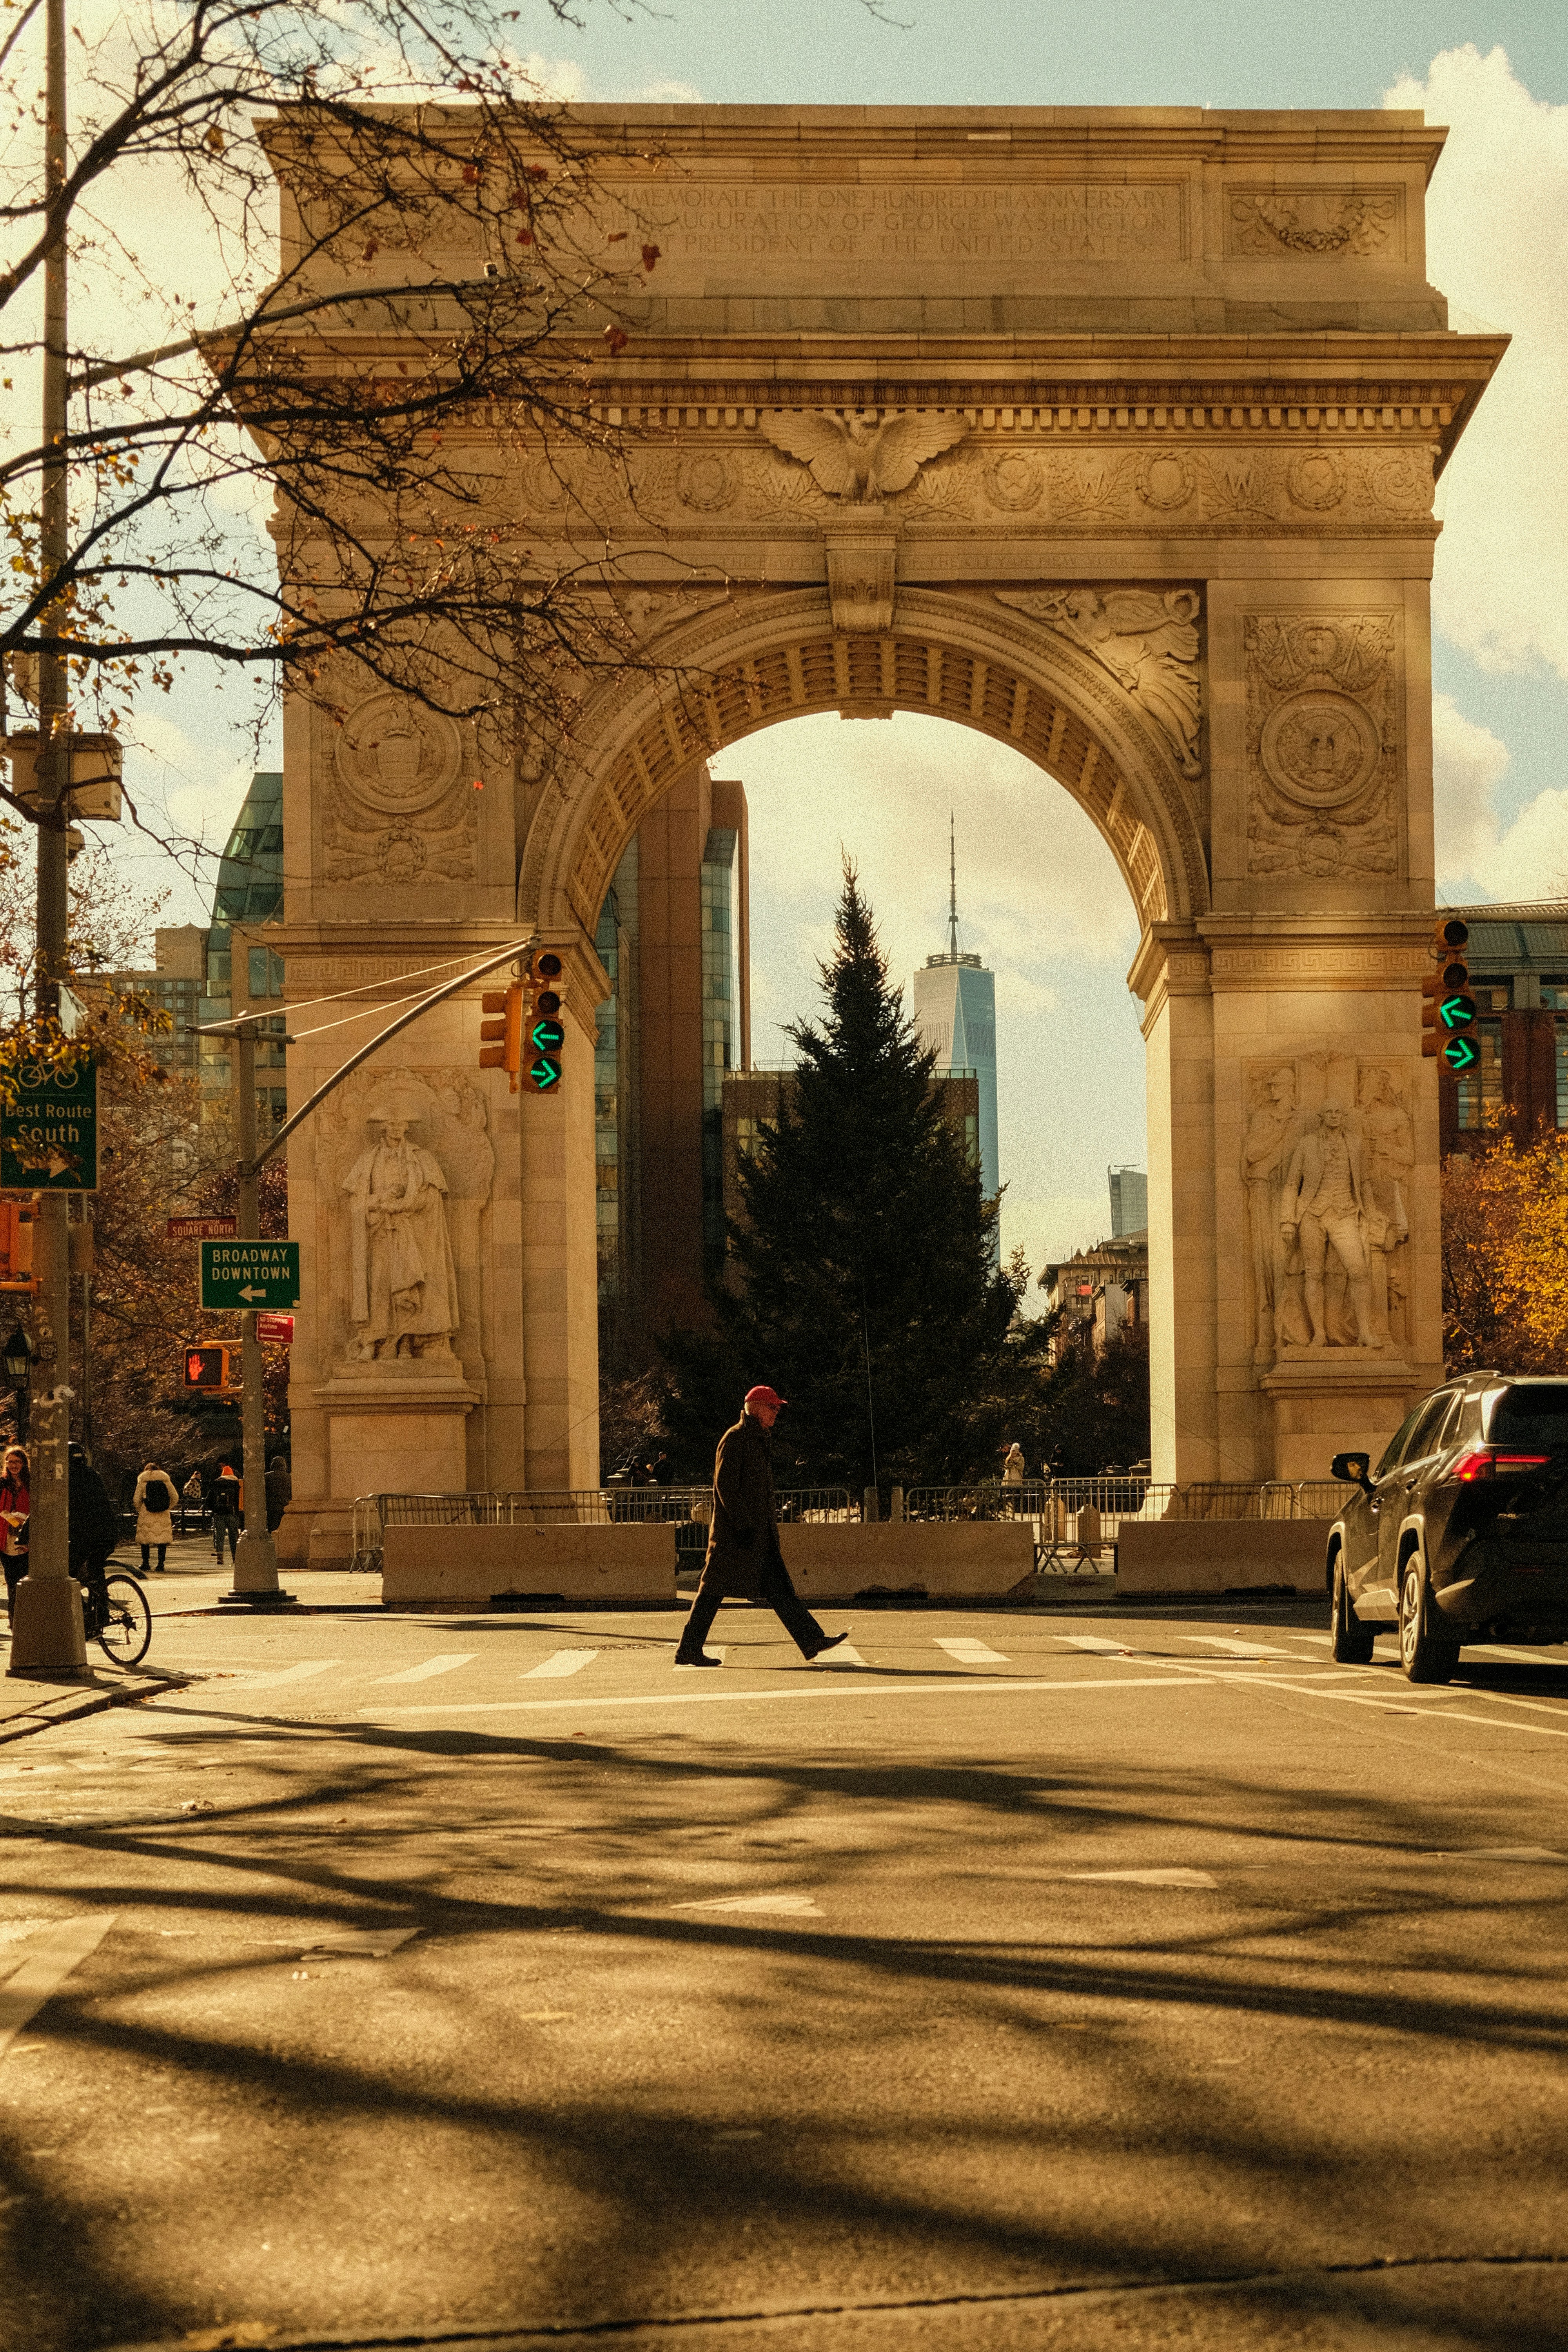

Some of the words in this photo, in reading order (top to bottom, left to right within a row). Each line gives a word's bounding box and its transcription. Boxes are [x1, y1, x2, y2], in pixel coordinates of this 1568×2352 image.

[766, 189, 812, 208] THE
[818, 189, 865, 208] ONE
[872, 189, 1009, 209] HUNDREDTH
[1014, 189, 1169, 209] ANNIVERSARY
[842, 212, 875, 231] OF
[884, 212, 981, 231] GEORGE
[994, 212, 1167, 231] WASHINGTON
[686, 234, 817, 254] PRESIDENT
[828, 235, 862, 253] OF
[878, 235, 927, 254] THE
[940, 235, 1033, 254] UNITED
[5, 1103, 39, 1117] Best
[46, 1103, 91, 1118] Route
[18, 1124, 79, 1142] South
[172, 1225, 203, 1236] SQUARE
[208, 1224, 233, 1234] NORTH
[212, 1249, 287, 1262] BROADWAY
[212, 1267, 290, 1280] DOWNTOWN
